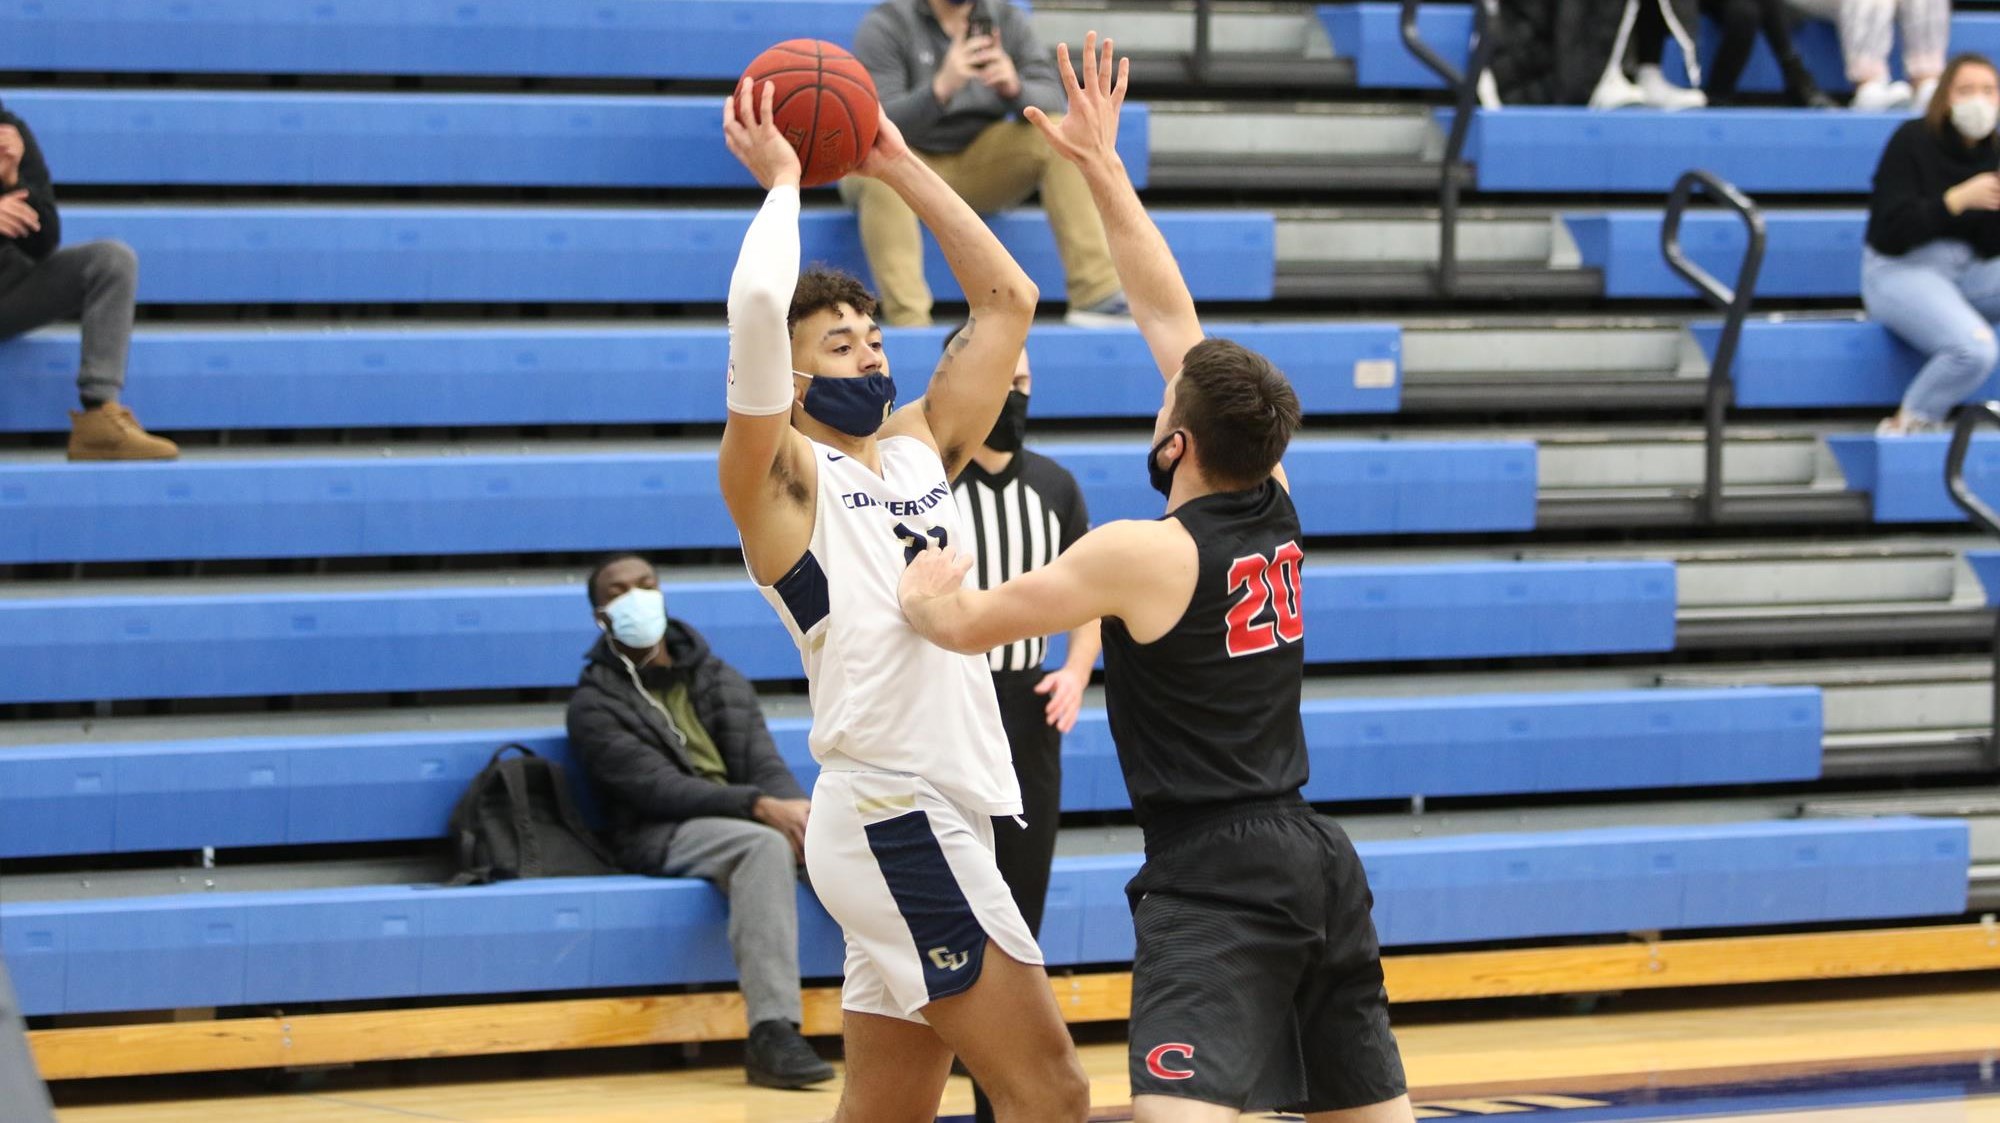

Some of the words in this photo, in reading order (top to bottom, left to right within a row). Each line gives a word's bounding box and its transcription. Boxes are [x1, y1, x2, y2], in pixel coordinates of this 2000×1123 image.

[1225, 540, 1304, 658] 20
[928, 946, 969, 971] CU
[1145, 1042, 1195, 1080] C
